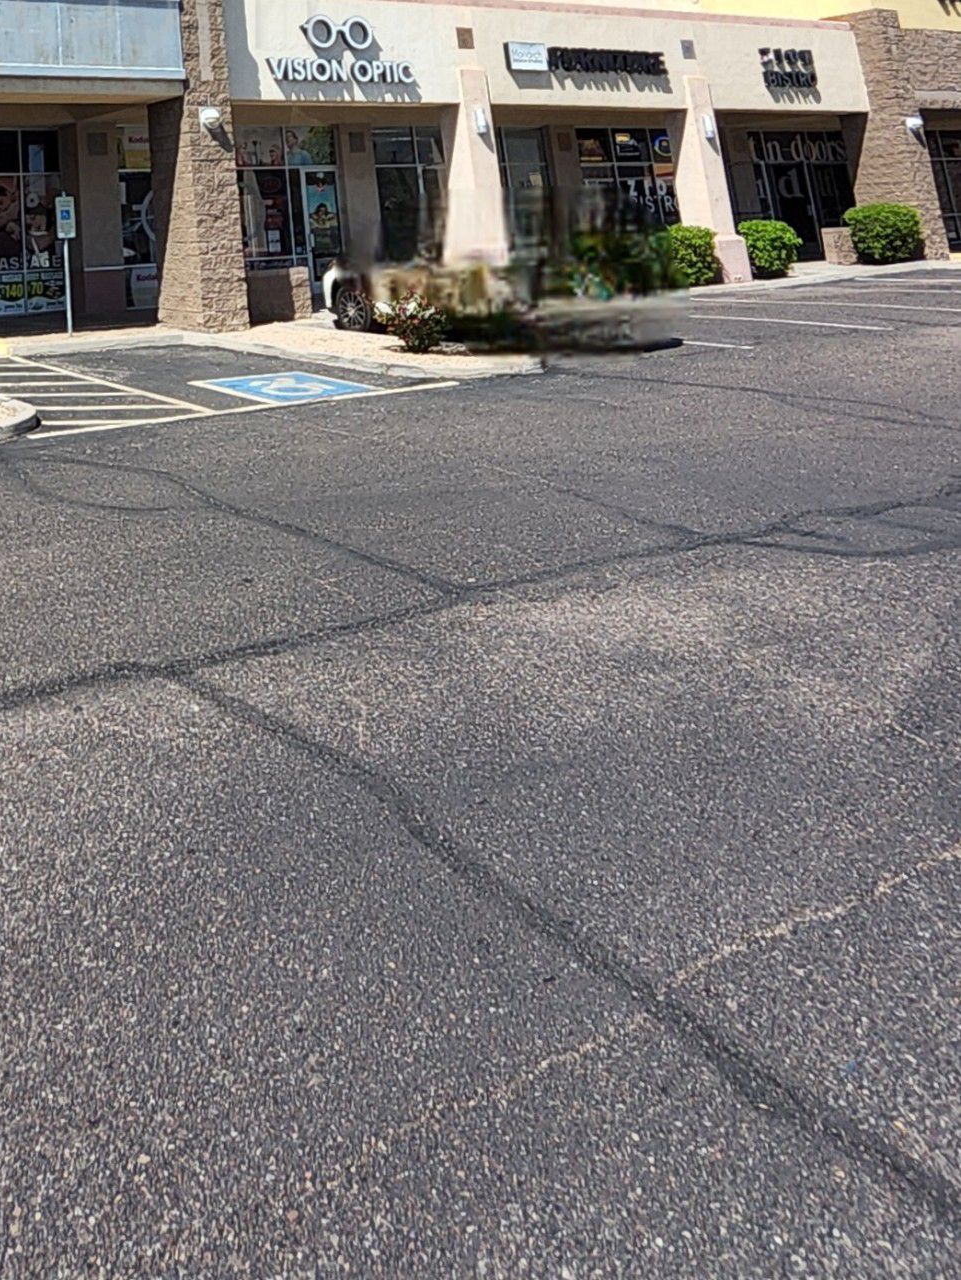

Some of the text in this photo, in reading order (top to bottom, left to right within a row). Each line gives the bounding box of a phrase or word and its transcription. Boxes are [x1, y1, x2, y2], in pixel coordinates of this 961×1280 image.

[548, 47, 667, 75] FURNITURE
[267, 58, 414, 83] VISION OPTIC
[762, 71, 818, 88] BISTRO
[128, 136, 150, 144] Koda
[136, 273, 158, 282] Koda
